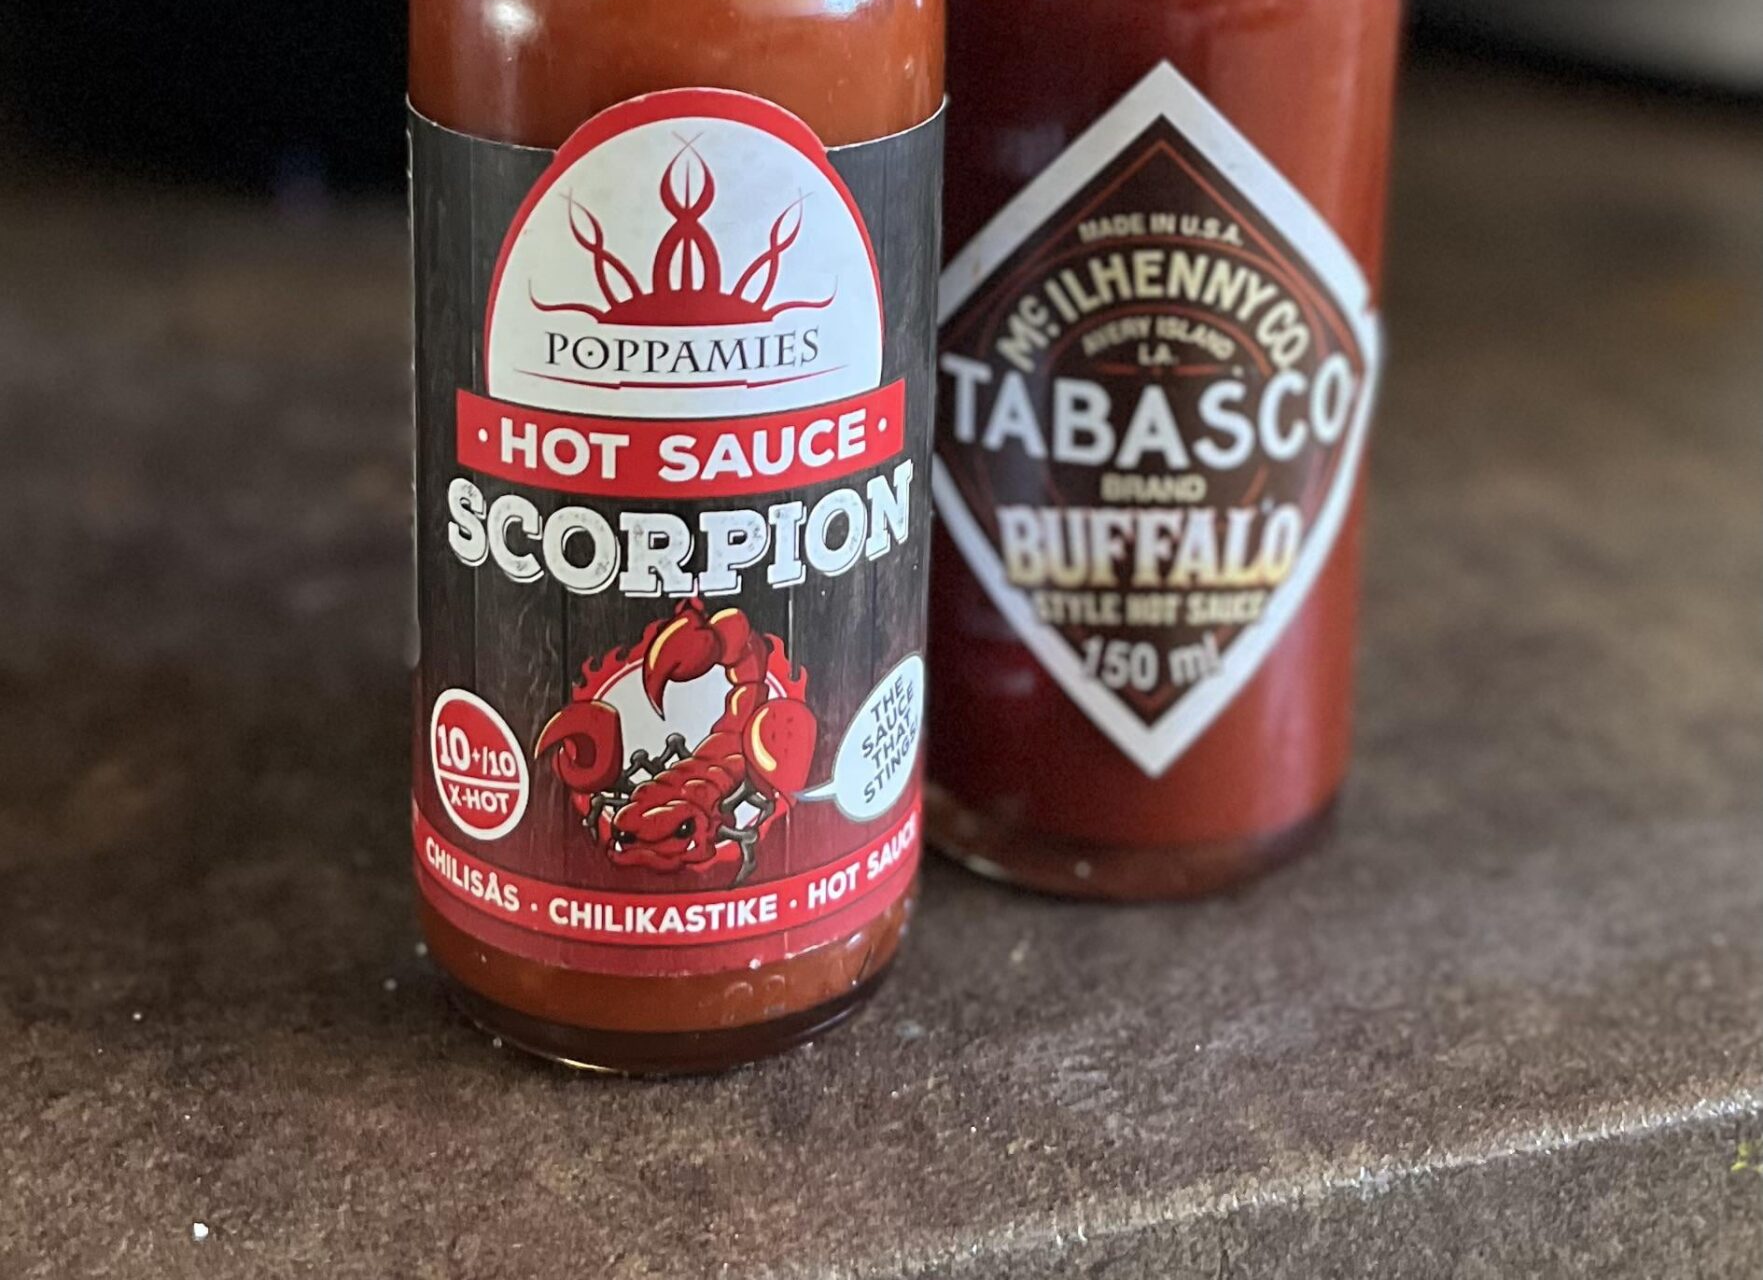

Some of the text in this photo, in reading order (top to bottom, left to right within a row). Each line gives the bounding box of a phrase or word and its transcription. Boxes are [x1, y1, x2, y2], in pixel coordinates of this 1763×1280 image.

[1078, 212, 1146, 243] MADE
[1150, 213, 1177, 235] IN
[544, 327, 821, 375] POPPAMIES
[941, 352, 1353, 472] TABASCO
[500, 408, 867, 483] HOT SAUCE
[1101, 473, 1207, 502] BRAND
[447, 458, 914, 598] SCORPION
[996, 503, 1302, 588] BUFFALO
[1034, 593, 1265, 626] STYLE HOT SAUCE
[1083, 636, 1159, 691] 150
[861, 680, 914, 758] SAUCE
[870, 675, 904, 723] THE
[871, 707, 911, 769] THAT
[448, 783, 510, 815] X-HOT
[425, 836, 520, 912] CHILISÅS
[807, 861, 861, 910] HOT
[548, 894, 778, 934] CHILIKASTIKE
